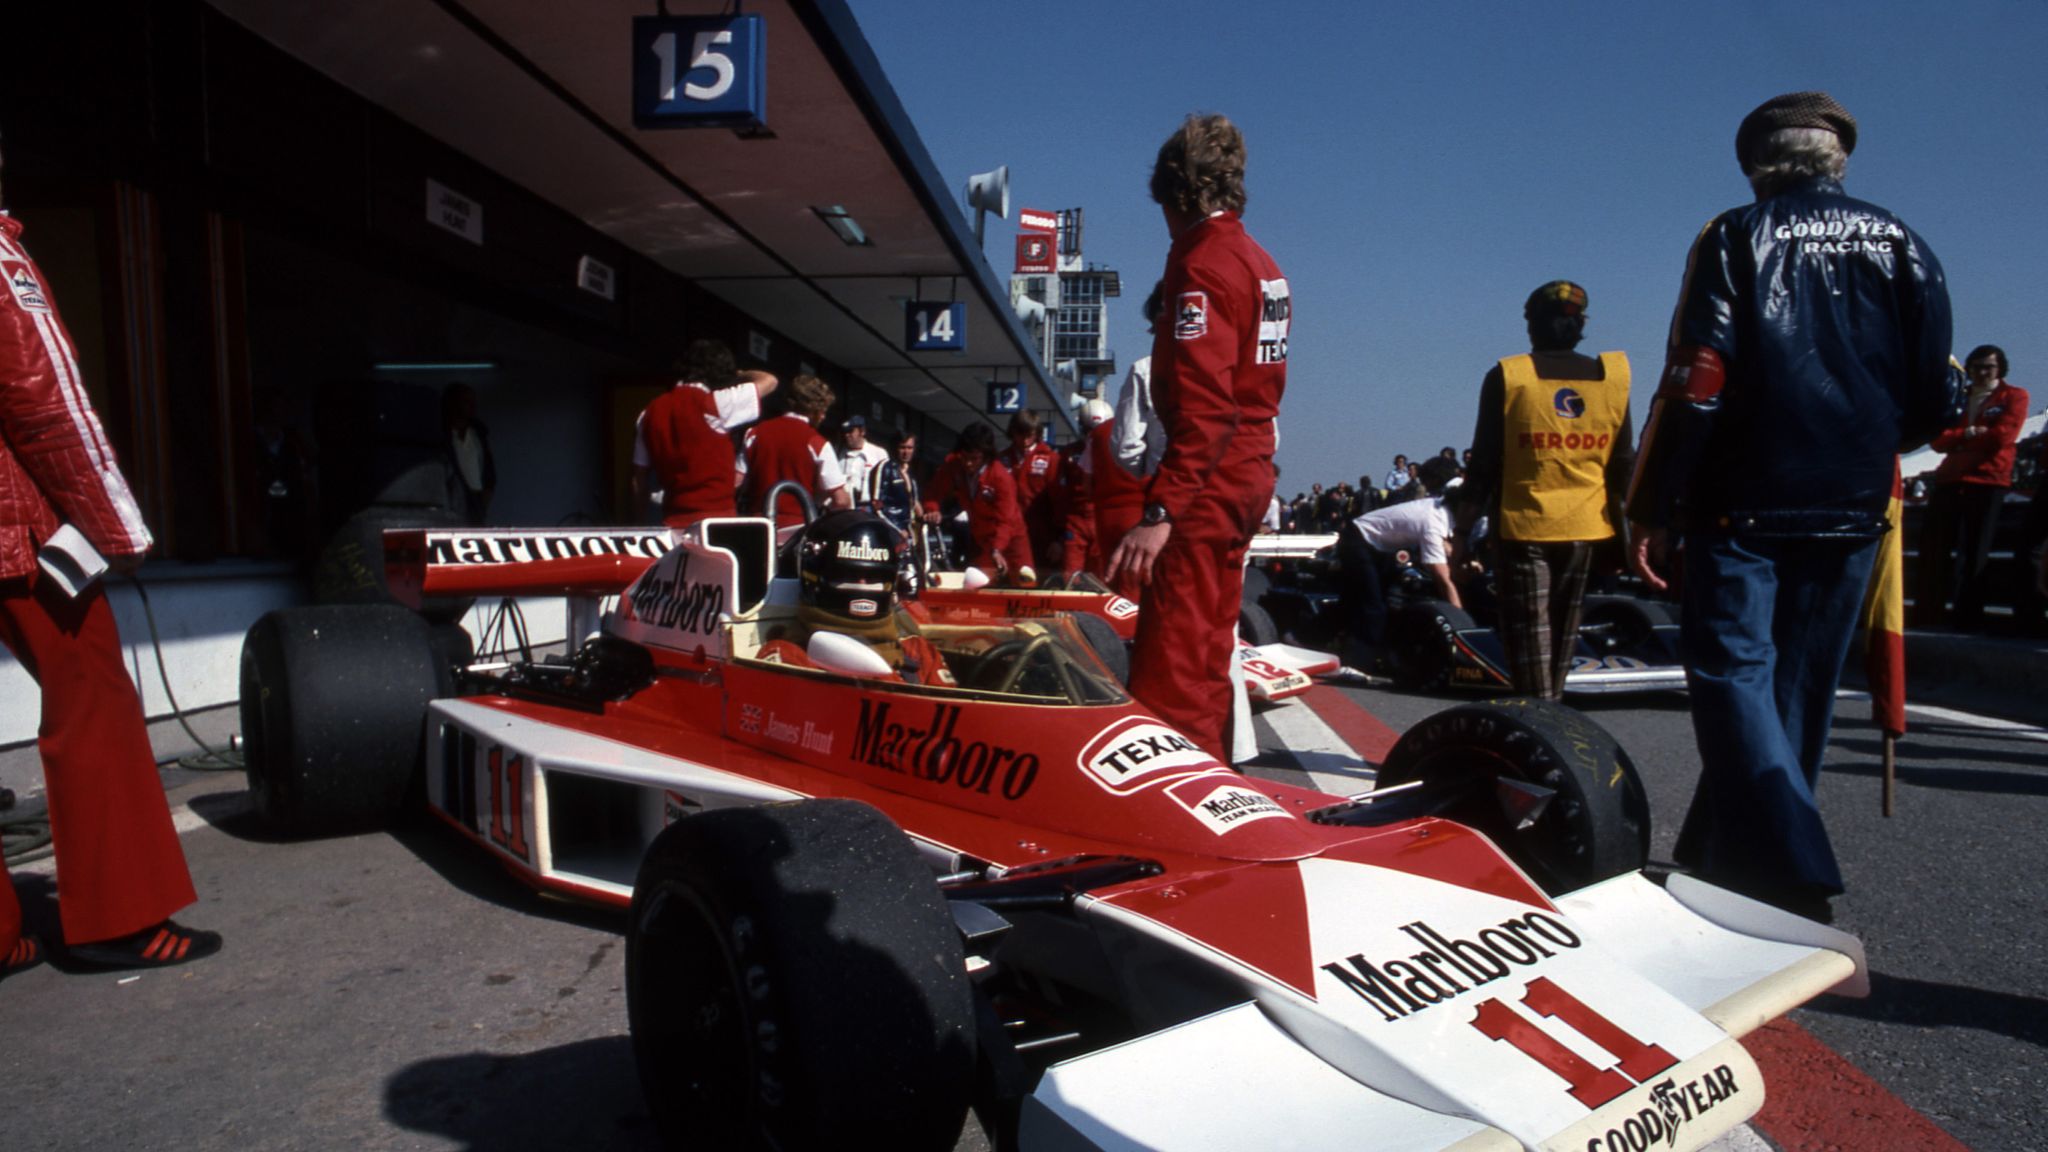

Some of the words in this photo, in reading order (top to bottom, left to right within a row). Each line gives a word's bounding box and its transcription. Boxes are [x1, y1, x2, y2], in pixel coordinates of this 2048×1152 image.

[651, 31, 735, 100] 15
[1031, 243, 1041, 256] F
[1804, 241, 1892, 253] RACING
[916, 309, 955, 341] 14
[994, 387, 1020, 409] 12
[1519, 432, 1609, 450] FERODO
[837, 537, 890, 561] Marlboro
[1456, 667, 1483, 681] FINA
[764, 711, 800, 745] James
[801, 720, 834, 756] Hunt
[850, 697, 1040, 800] Marlboro
[488, 743, 530, 864] 11
[1219, 810, 1248, 823] TEAM
[1320, 911, 1582, 1022] Marlboro
[1468, 976, 1682, 1111] 11
